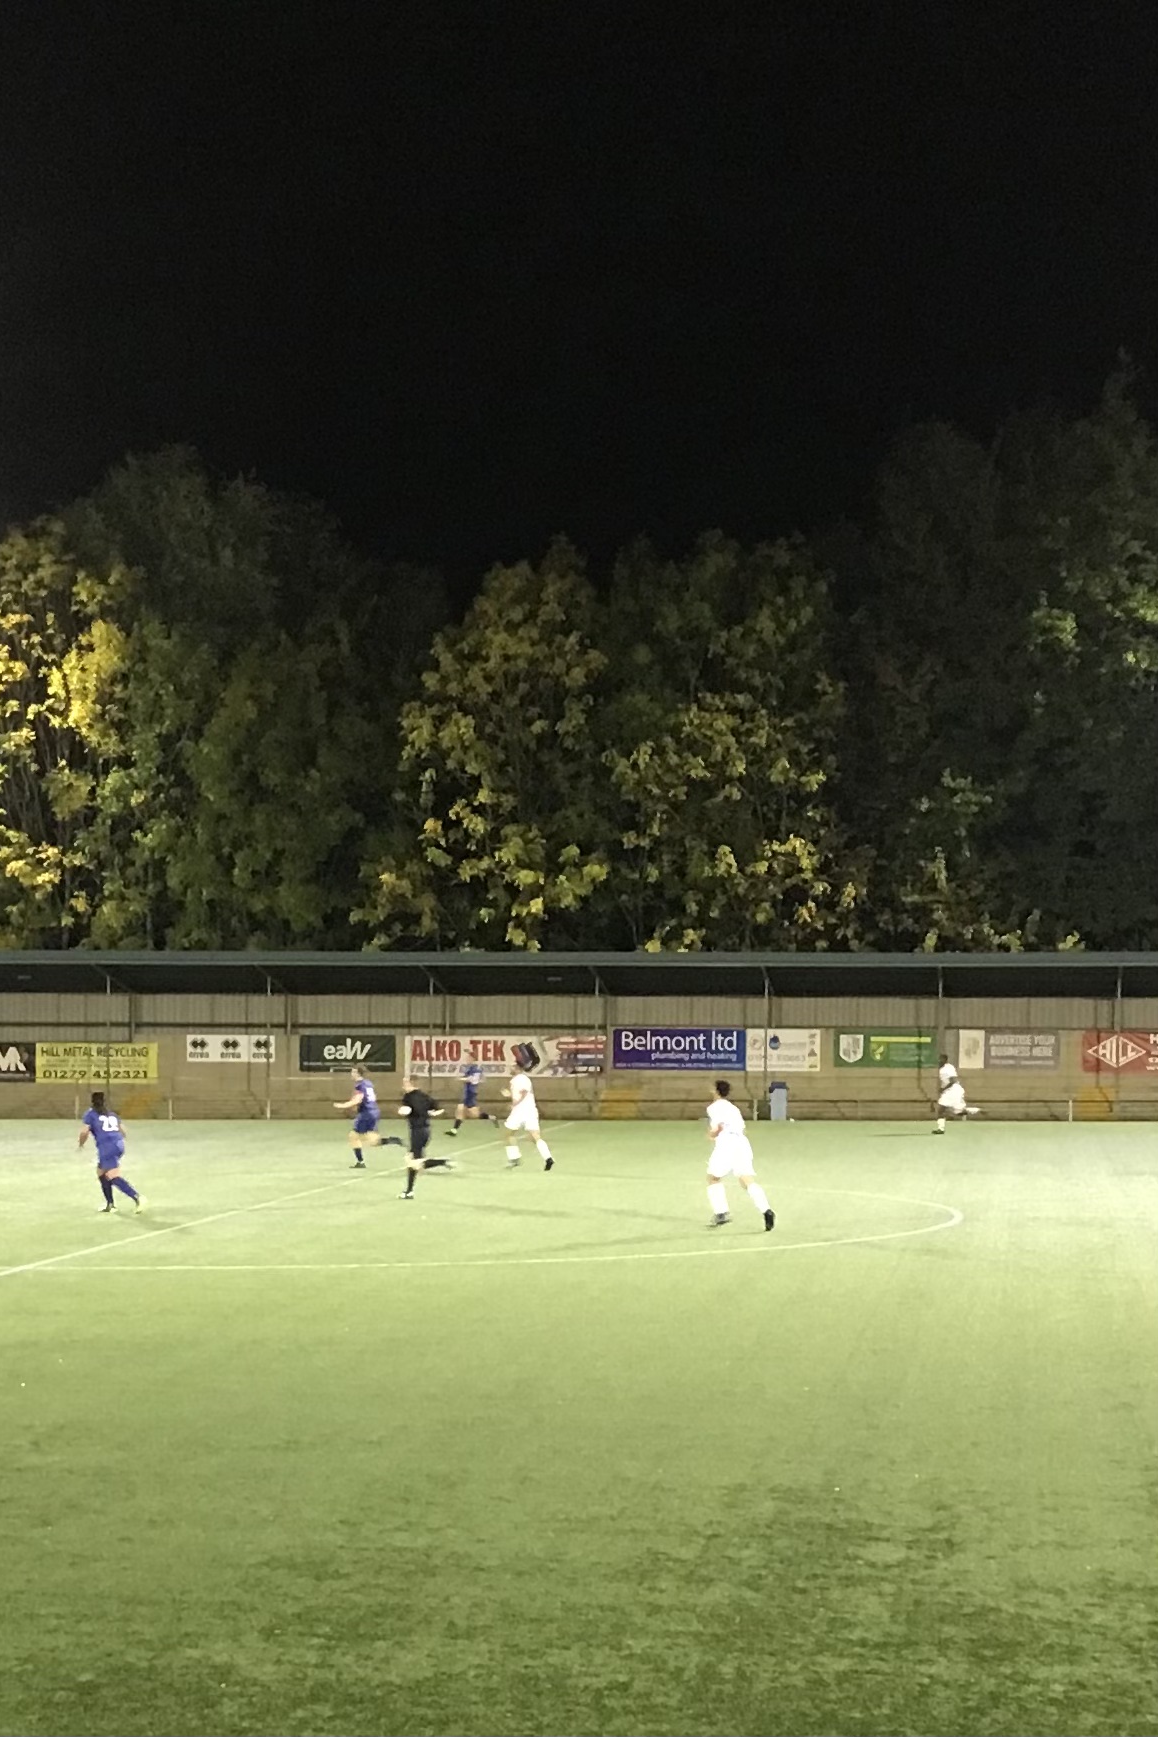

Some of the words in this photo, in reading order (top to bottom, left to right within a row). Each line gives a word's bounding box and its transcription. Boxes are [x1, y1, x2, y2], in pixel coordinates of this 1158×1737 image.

[621, 1030, 707, 1051] Belmont
[711, 1030, 738, 1051] ltd
[40, 1046, 60, 1057] HILL
[63, 1046, 94, 1057] METAL
[96, 1046, 149, 1058] RECYCLING
[42, 1069, 87, 1079] 01279
[92, 1069, 148, 1079] 452321
